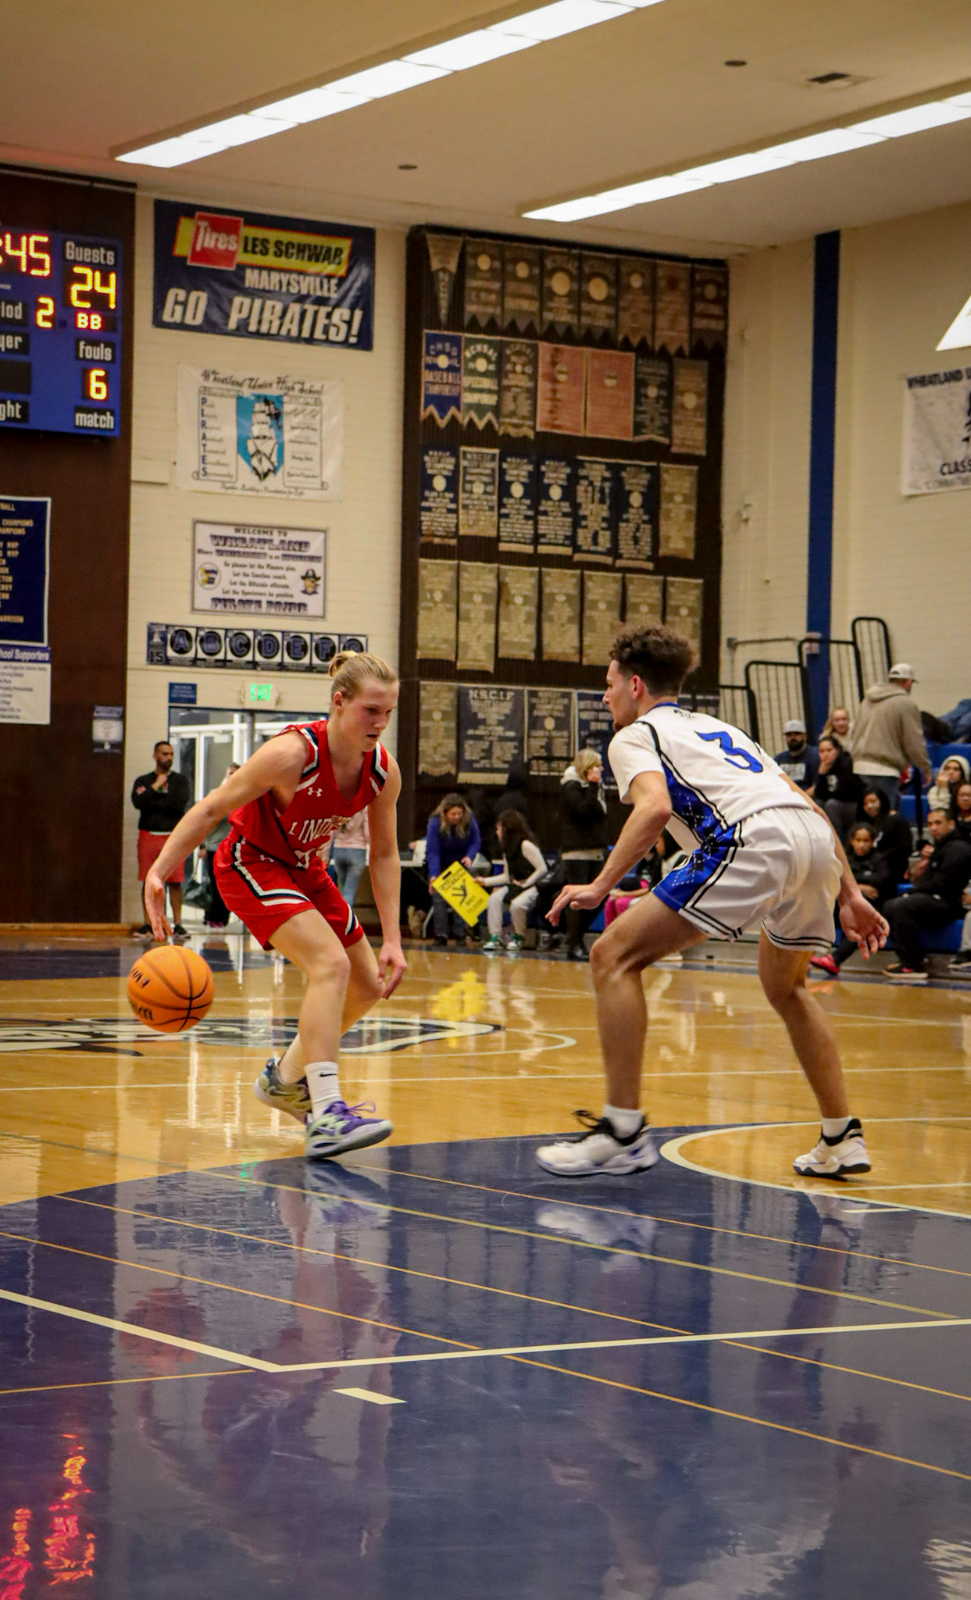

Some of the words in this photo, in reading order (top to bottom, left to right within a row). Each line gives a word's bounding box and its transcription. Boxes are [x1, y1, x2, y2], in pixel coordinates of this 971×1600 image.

[196, 220, 238, 252] Tires
[65, 241, 115, 265] Guests
[243, 236, 269, 257] LES
[273, 240, 343, 266] SCHWAB
[71, 266, 116, 309] 24
[245, 268, 339, 298] MARYSVILLE
[36, 297, 54, 328] 2
[76, 313, 102, 330] BB
[162, 288, 208, 325] GO
[227, 295, 363, 344] PIRATES!
[89, 369, 107, 400] 6
[201, 370, 245, 388] Wheatland
[75, 411, 114, 430] match
[234, 528, 273, 536] WELCOME
[14, 649, 50, 662] Supporters
[150, 651, 163, 663] 15
[250, 683, 273, 701] EXIT
[694, 730, 763, 773] 3
